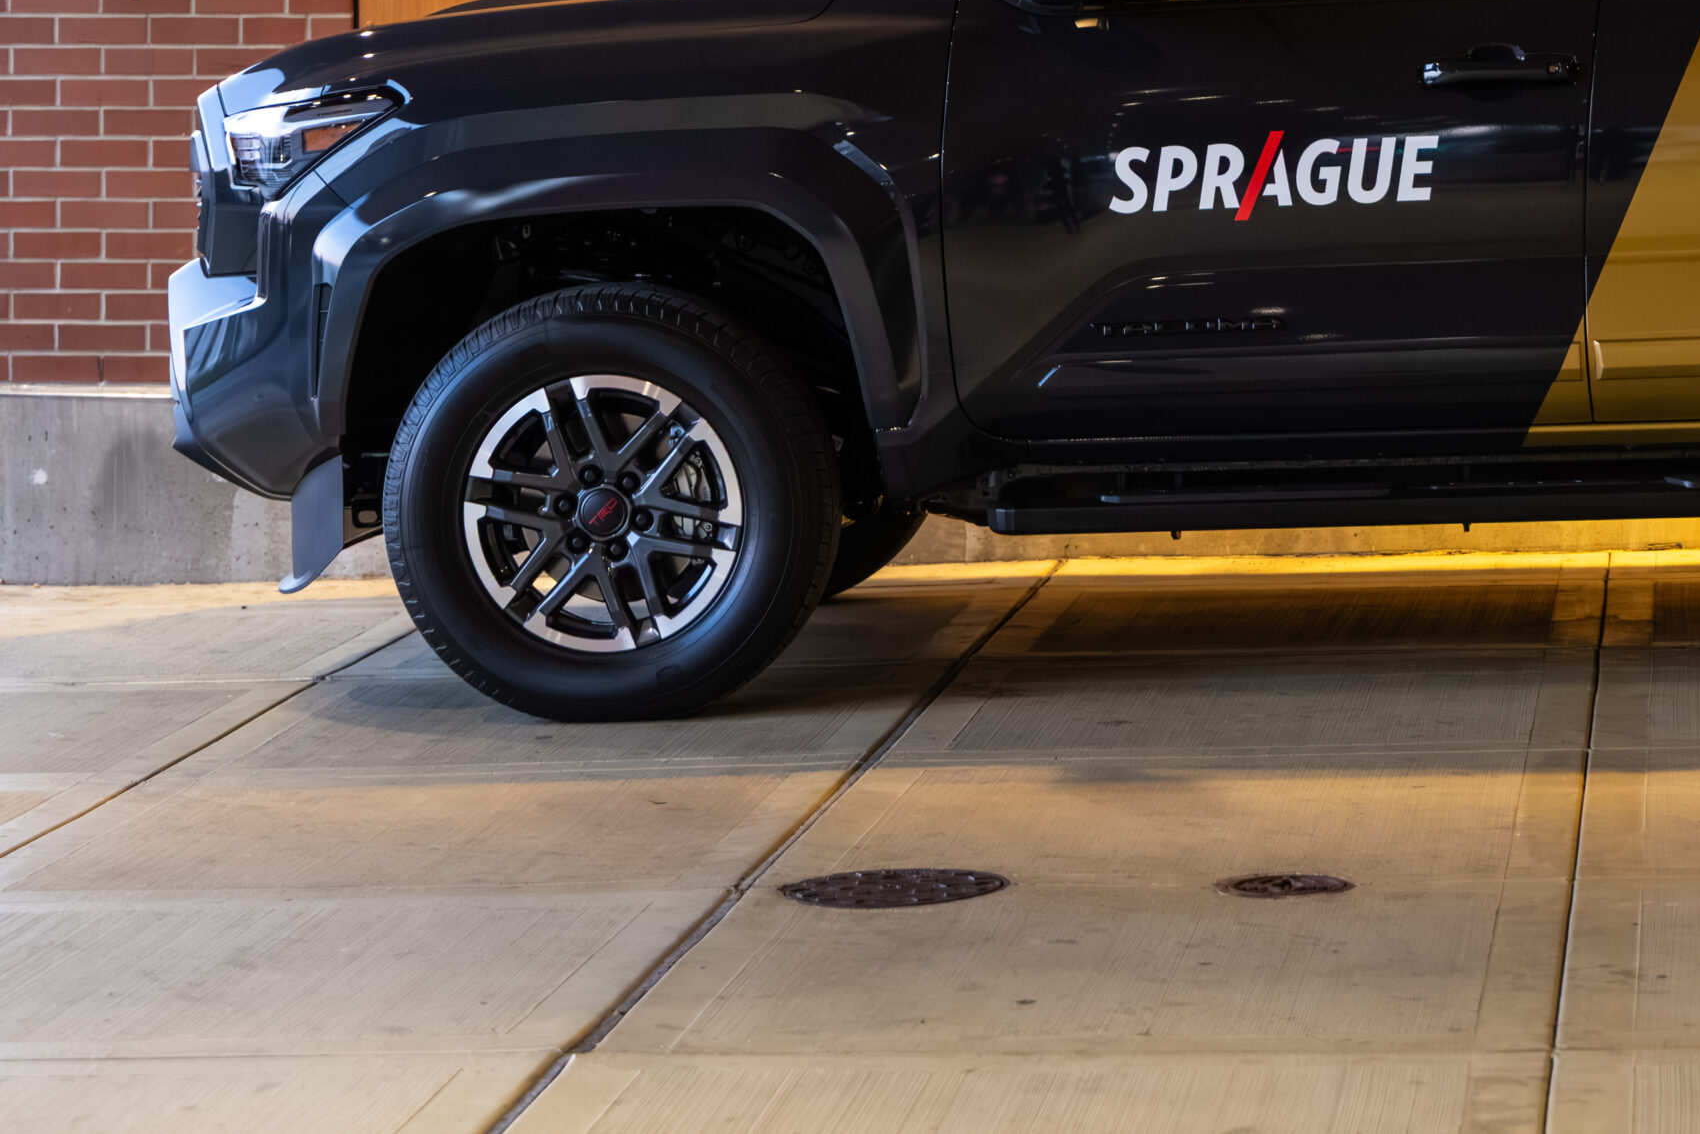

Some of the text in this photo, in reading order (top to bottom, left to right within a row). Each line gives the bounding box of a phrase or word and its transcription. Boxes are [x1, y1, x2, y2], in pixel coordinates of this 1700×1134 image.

[1108, 130, 1439, 221] SPRAGUE
[1088, 316, 1286, 337] TACOMA
[588, 497, 619, 527] TRD
